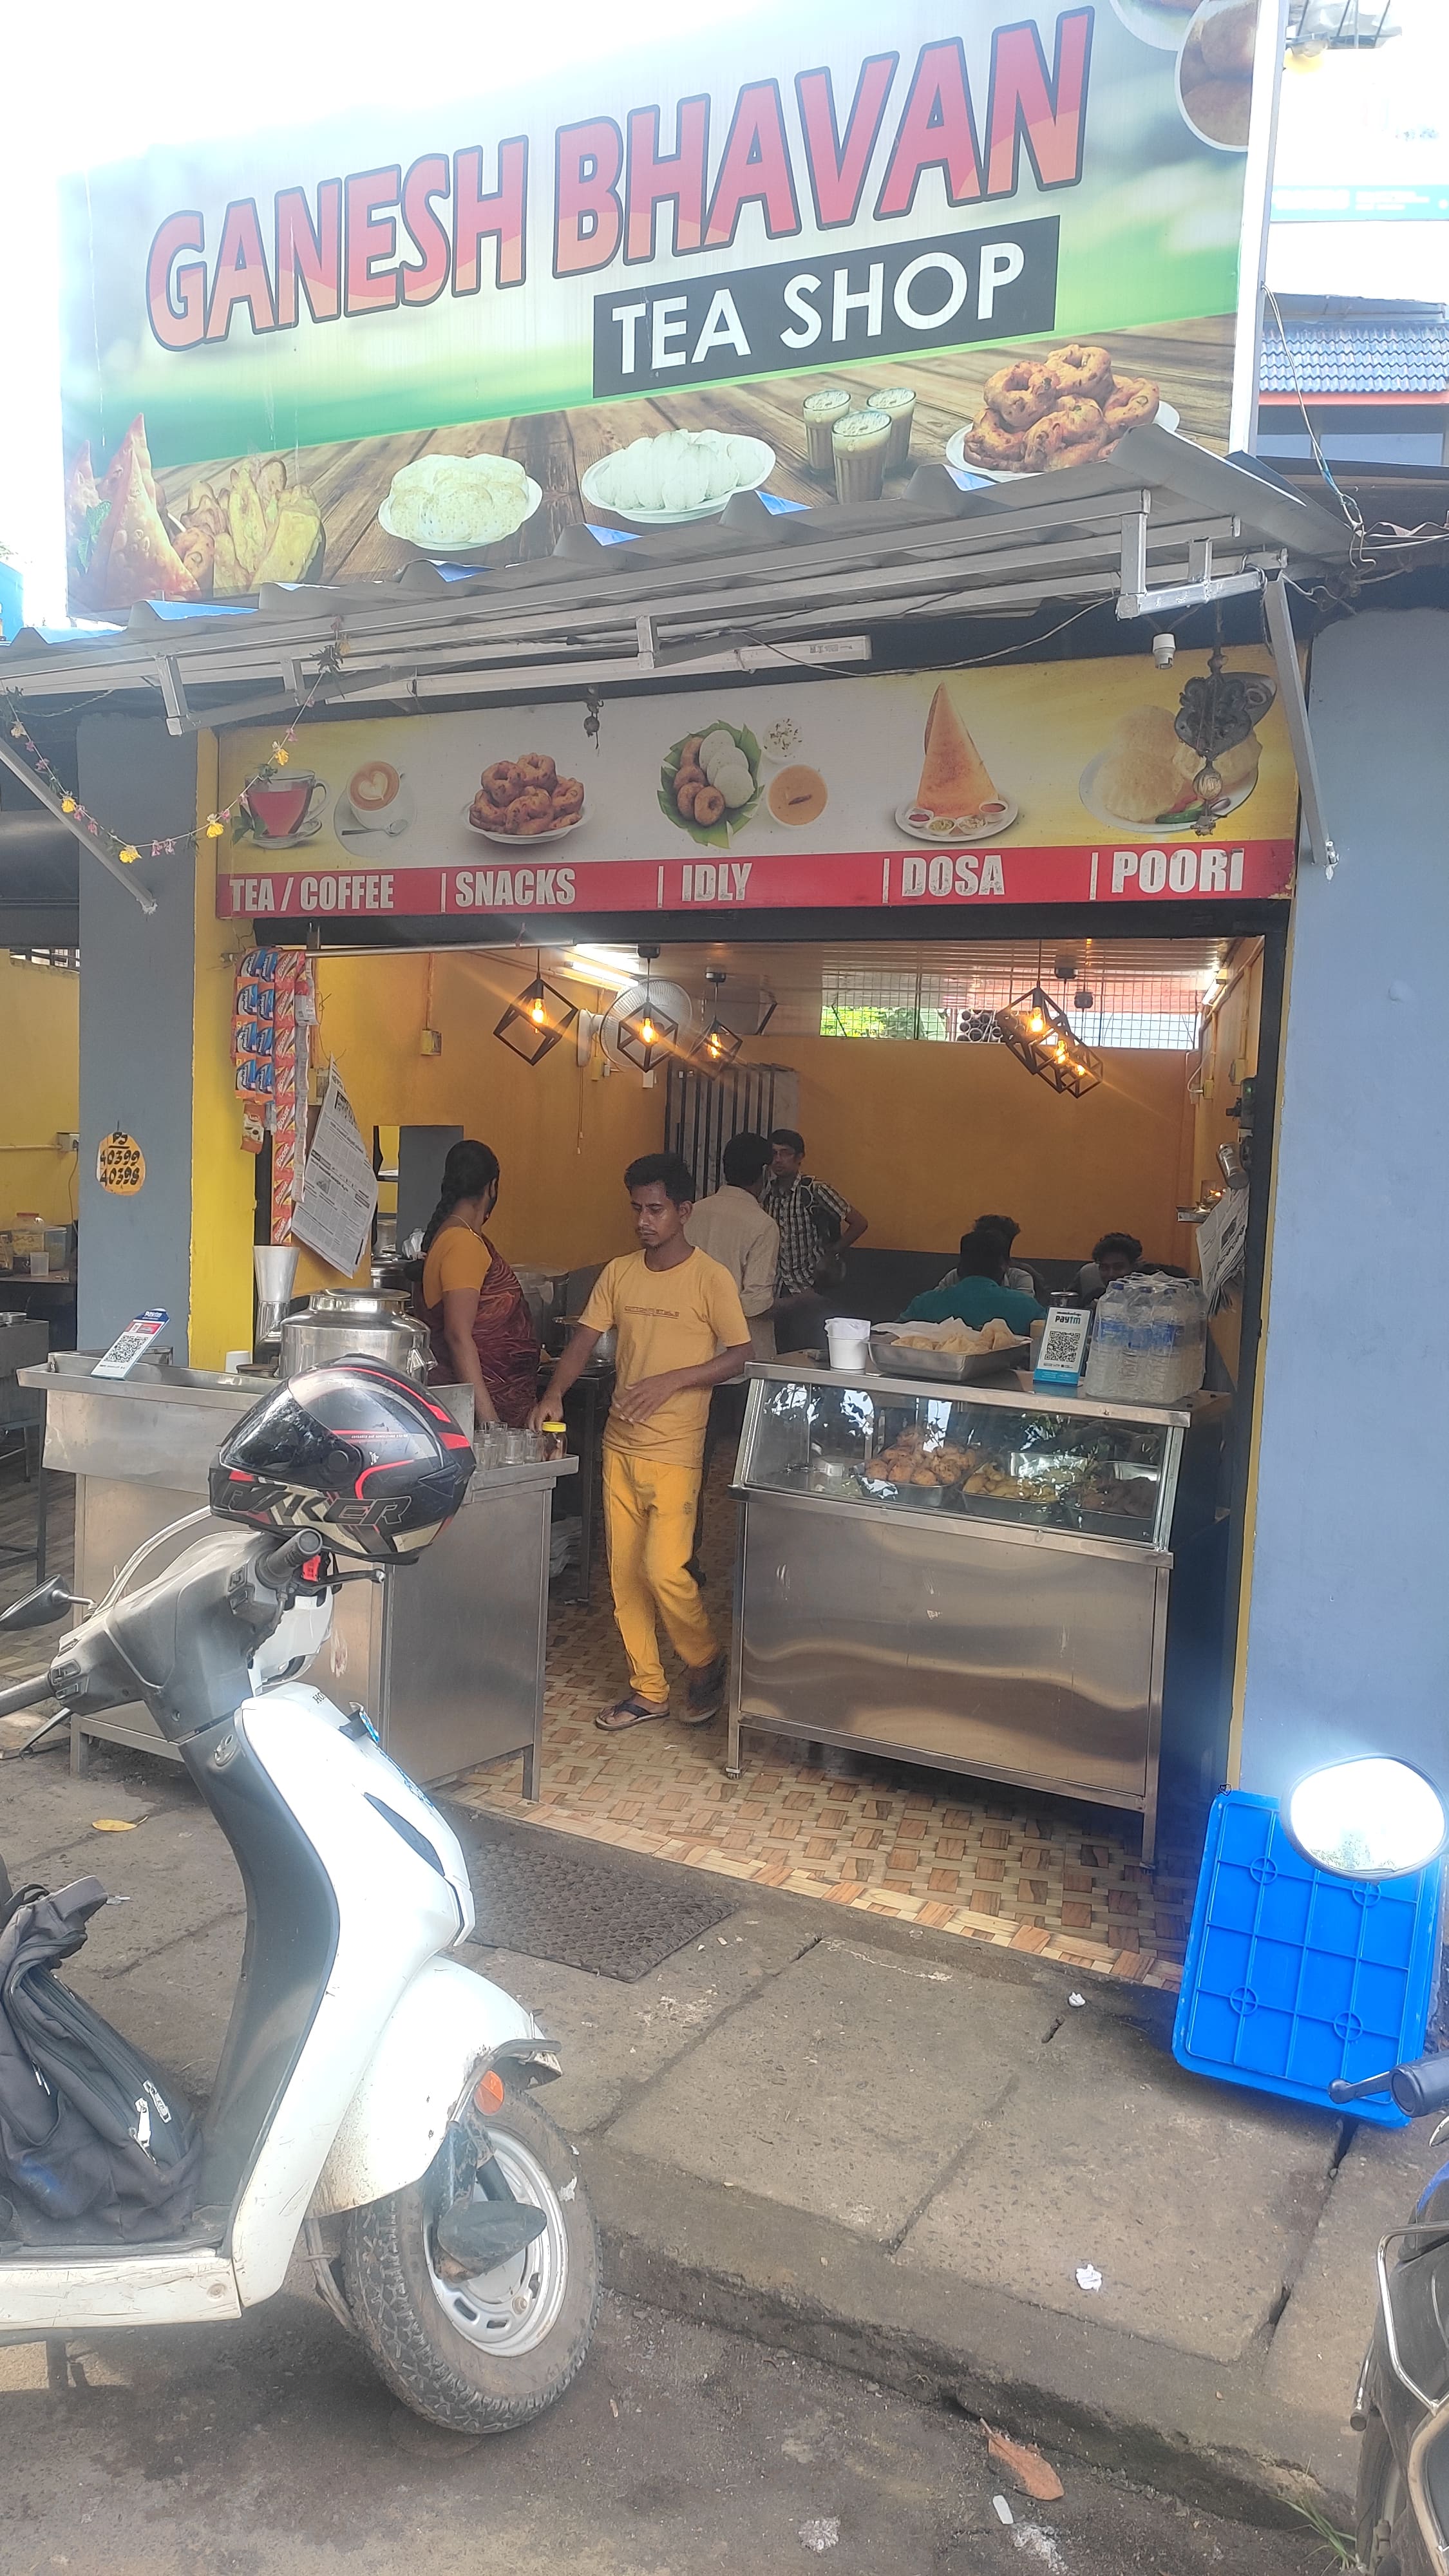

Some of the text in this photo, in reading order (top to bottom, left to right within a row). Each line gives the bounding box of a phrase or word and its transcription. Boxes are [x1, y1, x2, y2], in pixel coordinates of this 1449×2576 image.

[146, 6, 1094, 351] GANESH BHAVAN
[612, 242, 1025, 374] TEA SHOP
[455, 867, 576, 907] SNACKS
[681, 863, 753, 902] IDLY
[902, 855, 1005, 896] DOSA
[1111, 848, 1245, 893] POORI
[229, 878, 274, 911] TEA
[299, 874, 394, 910] COFFEE
